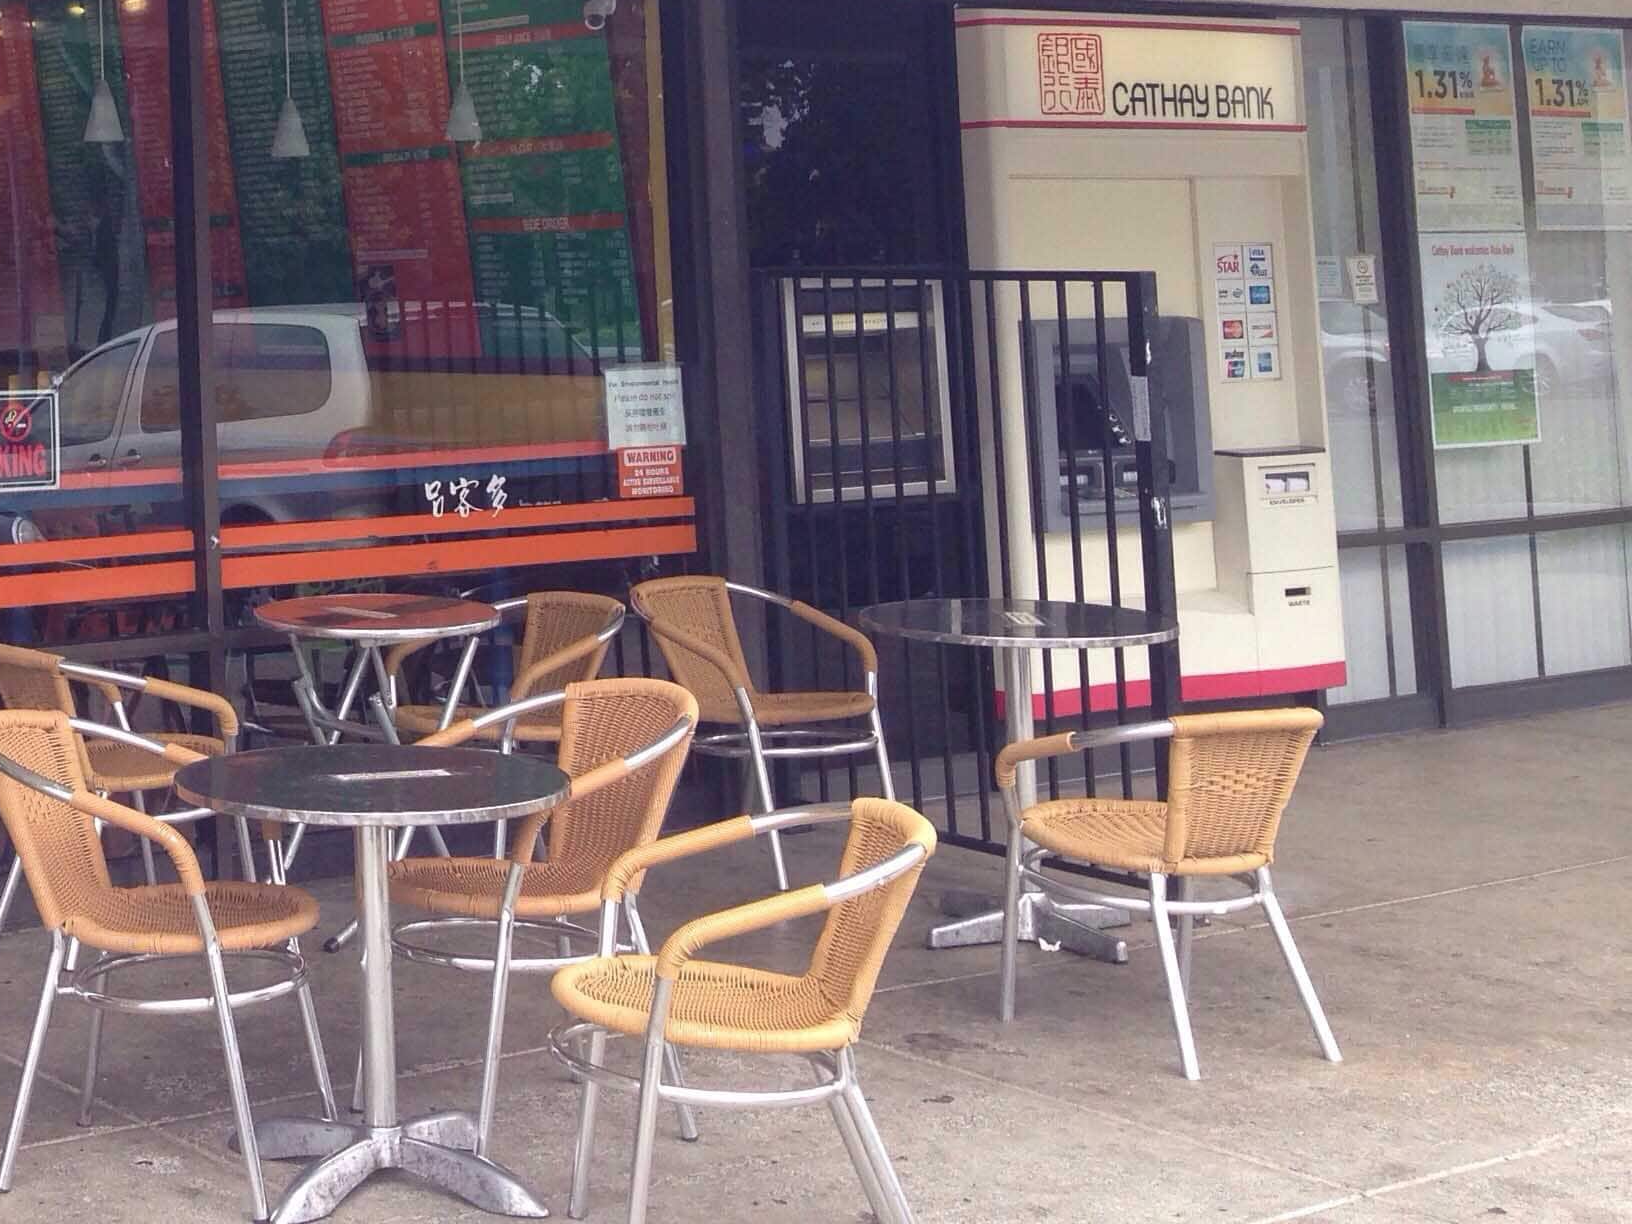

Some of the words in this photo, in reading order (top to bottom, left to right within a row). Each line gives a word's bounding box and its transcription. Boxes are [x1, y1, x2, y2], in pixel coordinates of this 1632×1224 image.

[1415, 70, 1473, 99] 1.31%
[1535, 78, 1588, 108] 1.31%
[1112, 81, 1210, 117] CATHAY
[1216, 85, 1274, 119] BANK
[1217, 261, 1240, 274] STAR
[626, 450, 674, 464] WARNING
